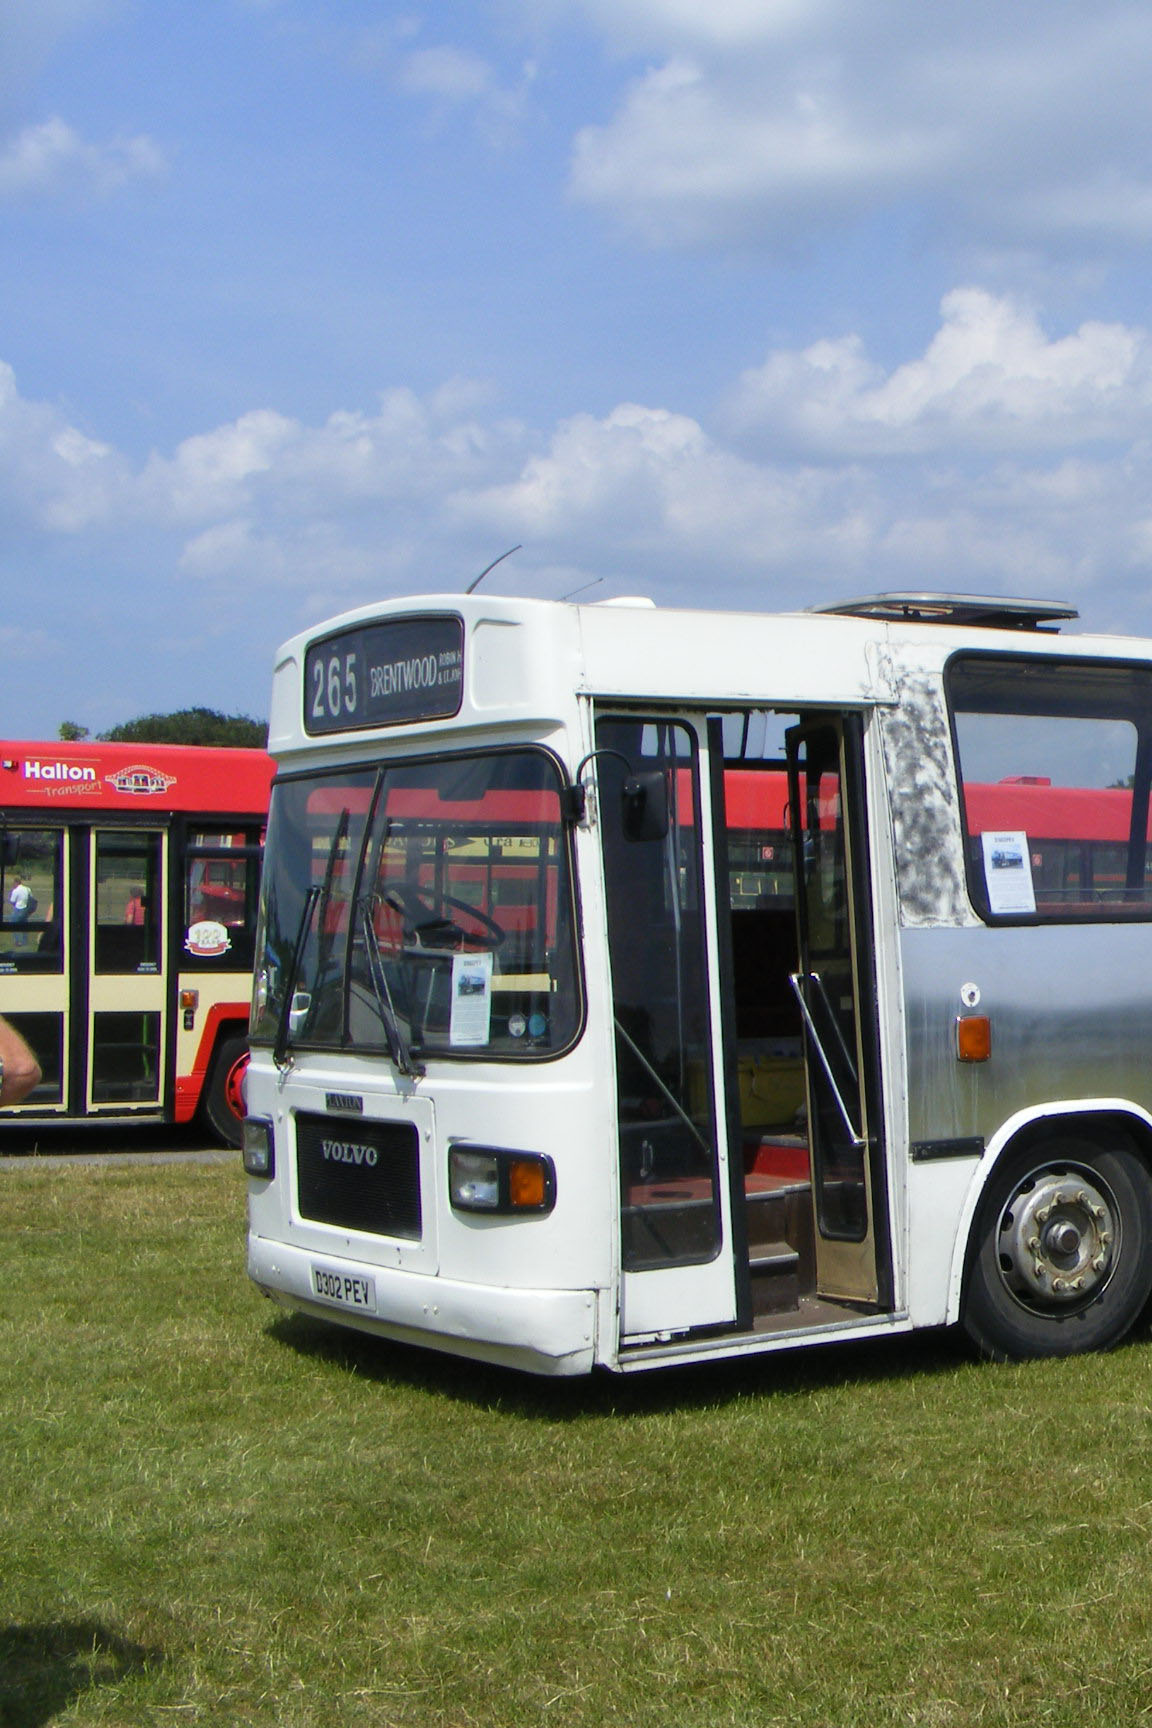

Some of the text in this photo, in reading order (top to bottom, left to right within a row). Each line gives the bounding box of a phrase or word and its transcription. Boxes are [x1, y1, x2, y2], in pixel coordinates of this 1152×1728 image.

[312, 653, 438, 718] 265 BRENTWOOD
[25, 761, 96, 781] Halton
[44, 780, 102, 797] Transport
[322, 1139, 378, 1167] VOLVO
[315, 1270, 369, 1304] D302 PEV
